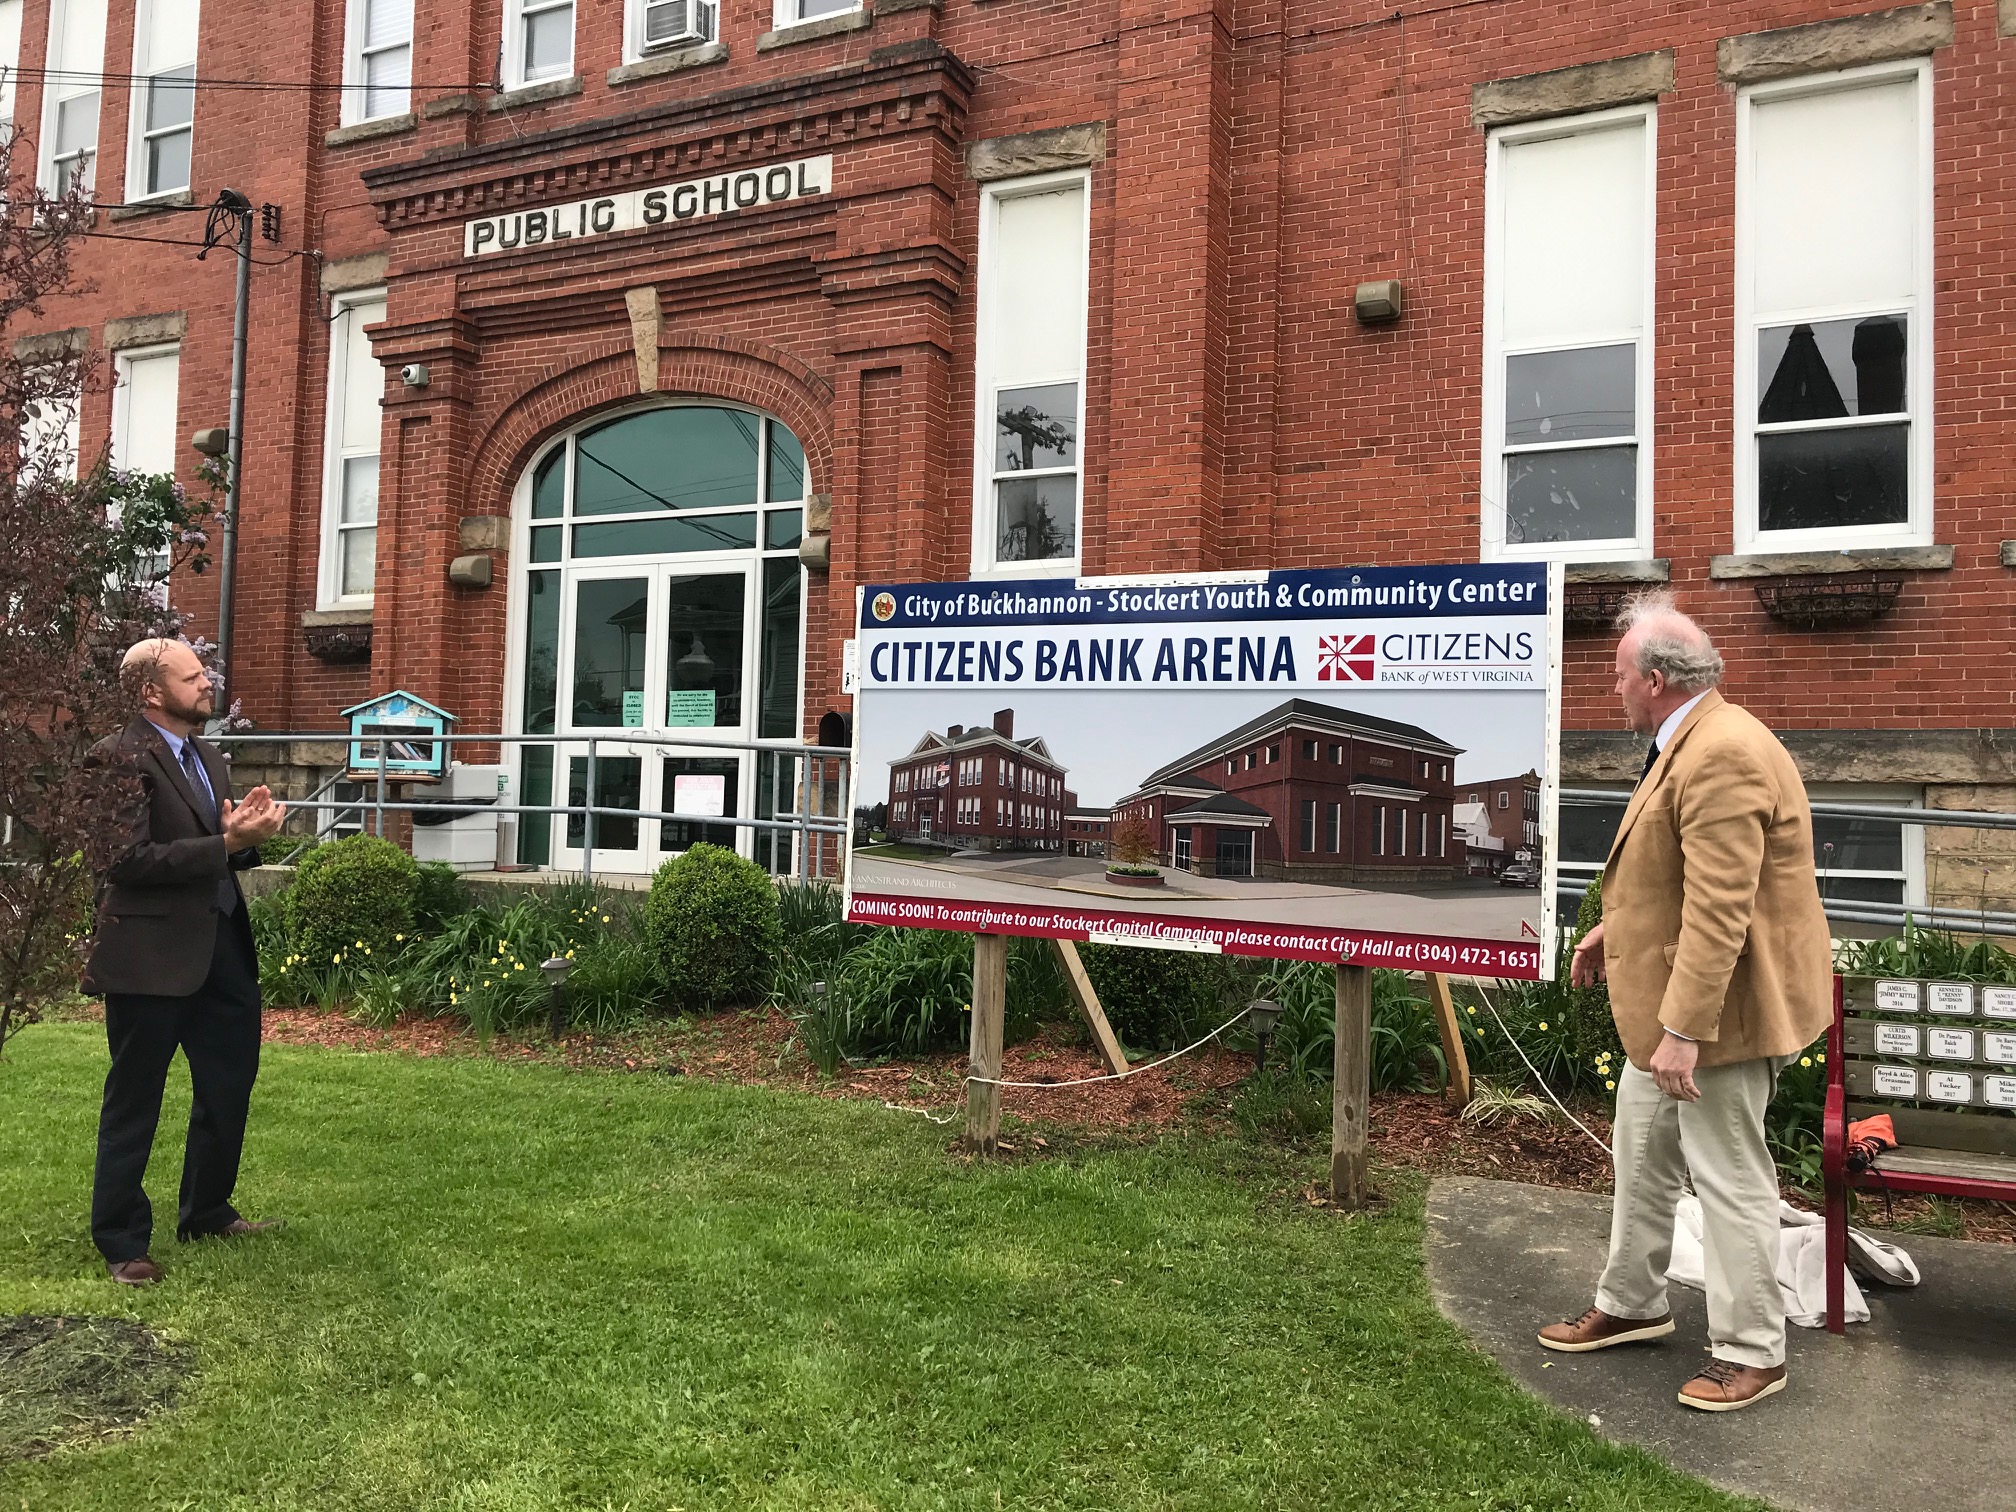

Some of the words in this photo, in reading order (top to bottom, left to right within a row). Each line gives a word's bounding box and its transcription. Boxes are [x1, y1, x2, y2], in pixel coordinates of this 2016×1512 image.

[472, 199, 615, 254] PUBLIC
[642, 162, 821, 225] SCHOOL
[904, 594, 940, 622] City
[944, 593, 965, 616] of
[969, 592, 1091, 616] Buckhannon
[1107, 589, 1201, 612] Stockert
[1204, 584, 1269, 610] Youth
[1276, 583, 1293, 608] &
[1297, 580, 1443, 611] Community
[1448, 578, 1537, 602] Center
[870, 640, 1024, 682] CITIZENS
[1034, 638, 1143, 682] BANK
[1152, 636, 1297, 682] ARENA
[1381, 632, 1533, 662] CITIZENS
[1381, 671, 1416, 682] BANK
[1418, 670, 1431, 685] of
[1431, 671, 1470, 682] WEST
[1472, 671, 1533, 682] VIRGINIA
[852, 899, 897, 917] COMING
[898, 902, 934, 919] SOON!
[937, 906, 949, 920] To
[950, 908, 1012, 926] contribute
[1014, 912, 1027, 926] to
[1029, 915, 1051, 928] our
[1051, 914, 1104, 932] Stockert
[1106, 919, 1153, 936] Capital
[1225, 928, 1271, 946] please
[1273, 933, 1329, 951] contact
[1330, 936, 1359, 957] City
[1361, 939, 1394, 956] Hall
[1395, 943, 1412, 958] at
[1414, 942, 1457, 964] (304)
[1460, 947, 1538, 969] 472-1651
